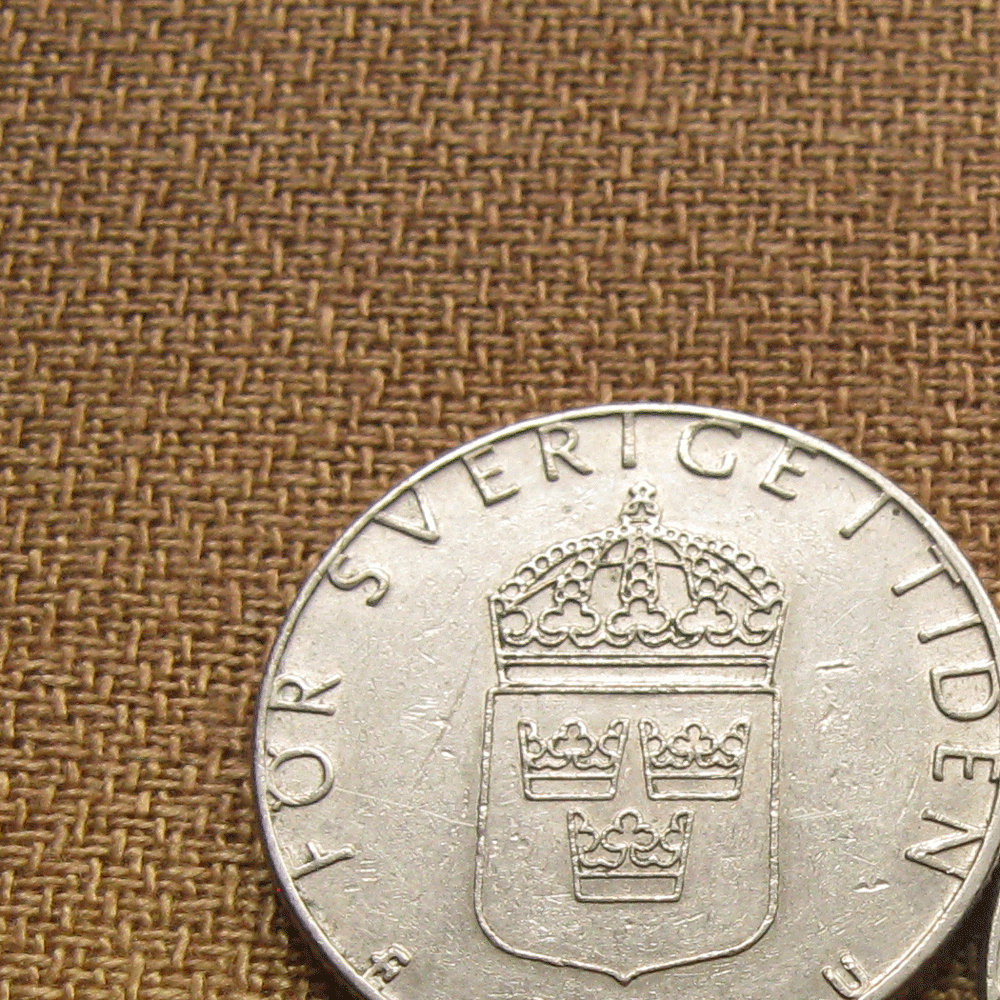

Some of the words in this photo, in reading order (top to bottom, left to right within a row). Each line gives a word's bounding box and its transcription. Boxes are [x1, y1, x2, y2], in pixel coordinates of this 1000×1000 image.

[265, 673, 357, 881] FÖR
[326, 413, 821, 607] SVERIGE
[838, 490, 893, 540] I
